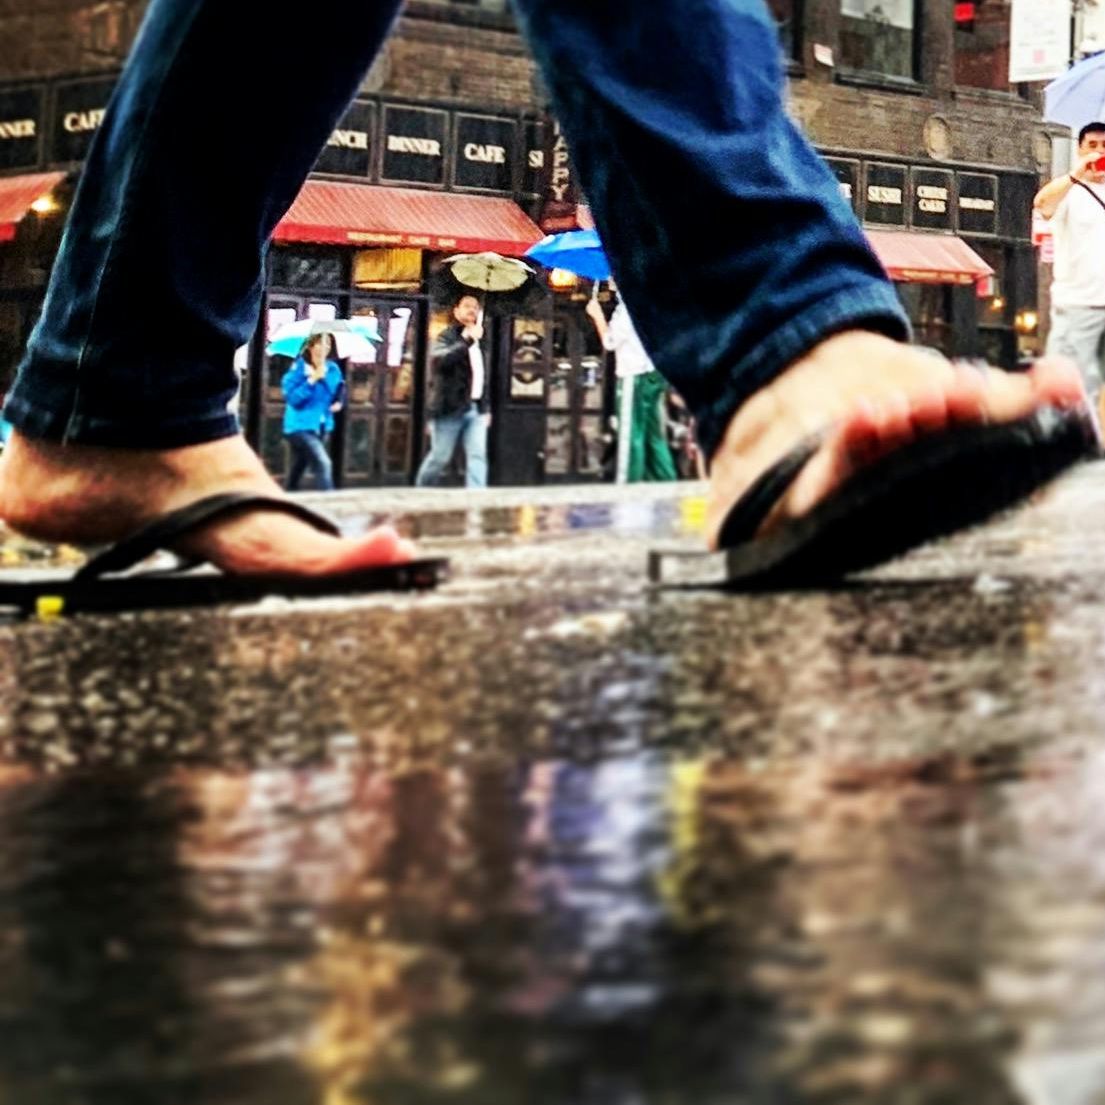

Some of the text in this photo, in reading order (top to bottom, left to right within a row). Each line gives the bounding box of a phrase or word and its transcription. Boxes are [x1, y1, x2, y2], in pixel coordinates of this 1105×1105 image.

[327, 129, 368, 150] NCH
[387, 134, 441, 156] DINNER
[463, 142, 506, 165] CAFE
